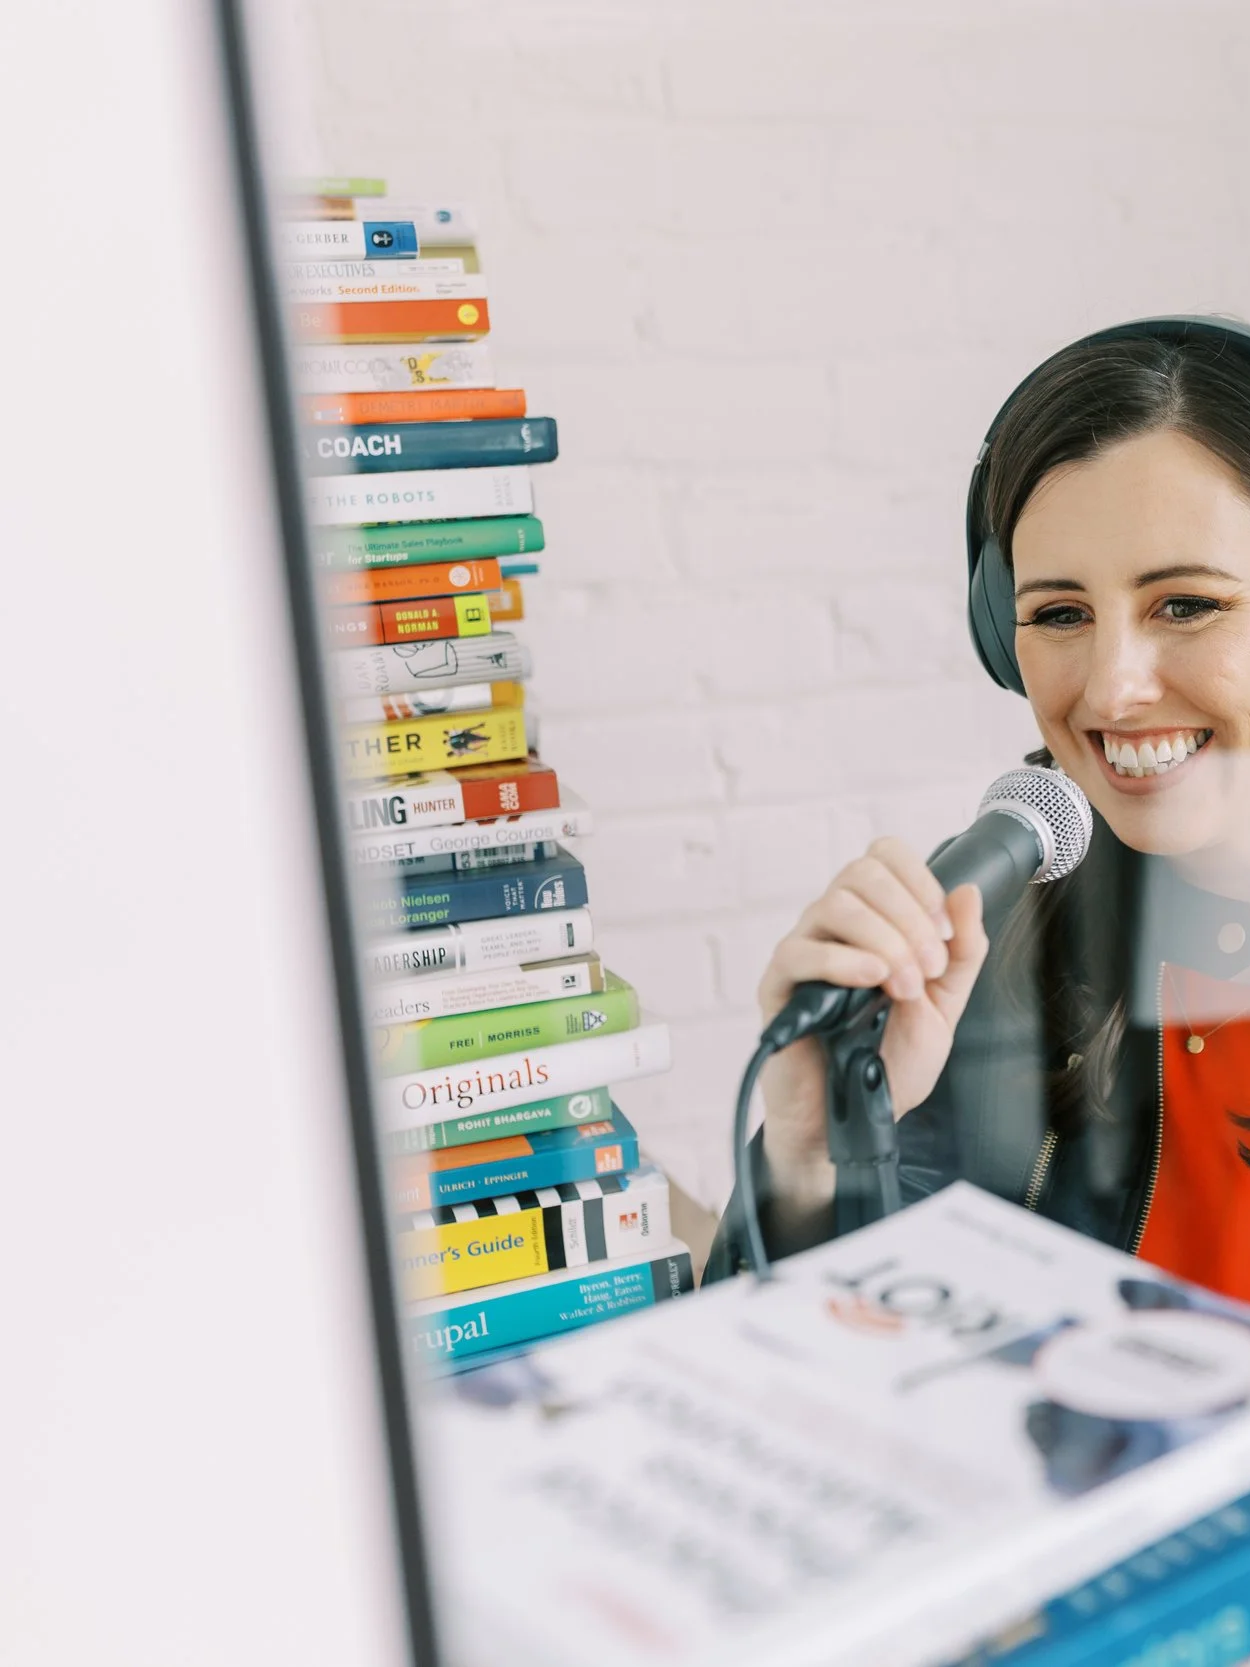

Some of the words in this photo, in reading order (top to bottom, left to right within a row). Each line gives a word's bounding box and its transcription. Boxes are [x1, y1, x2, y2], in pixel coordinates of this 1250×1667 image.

[296, 233, 350, 244] GERBER
[306, 263, 375, 279] EXECUTIVES
[338, 285, 378, 296] Second
[317, 433, 402, 458] COACH
[326, 494, 357, 508] THE
[366, 490, 436, 505] ROBOTS
[364, 539, 400, 551] Ultimate
[402, 537, 425, 548] Sales
[426, 535, 464, 547] Playbook
[348, 553, 363, 565] for
[364, 551, 409, 564] Startups
[395, 608, 430, 622] DONALD
[397, 620, 440, 635] NORMAN
[346, 732, 422, 759] THER
[351, 795, 407, 832] LING
[413, 797, 456, 815] HUNTER
[430, 833, 490, 853] George
[495, 823, 554, 842] Couros
[400, 891, 451, 909] Nielsen
[389, 908, 450, 928] Loranger
[449, 1037, 475, 1051] FREI
[488, 1026, 541, 1043] MORRISS
[401, 1056, 550, 1110] Originals
[457, 1117, 492, 1132] ROHIT
[494, 1107, 552, 1127] BHARGAVA
[439, 1179, 476, 1194] ULRICH
[484, 1170, 529, 1186] EPPINGER
[640, 1202, 650, 1237] Osborne
[467, 1233, 525, 1257] Guide
[559, 1305, 594, 1322] Walker
[595, 1303, 605, 1313] &
[411, 1311, 490, 1353] rupal
